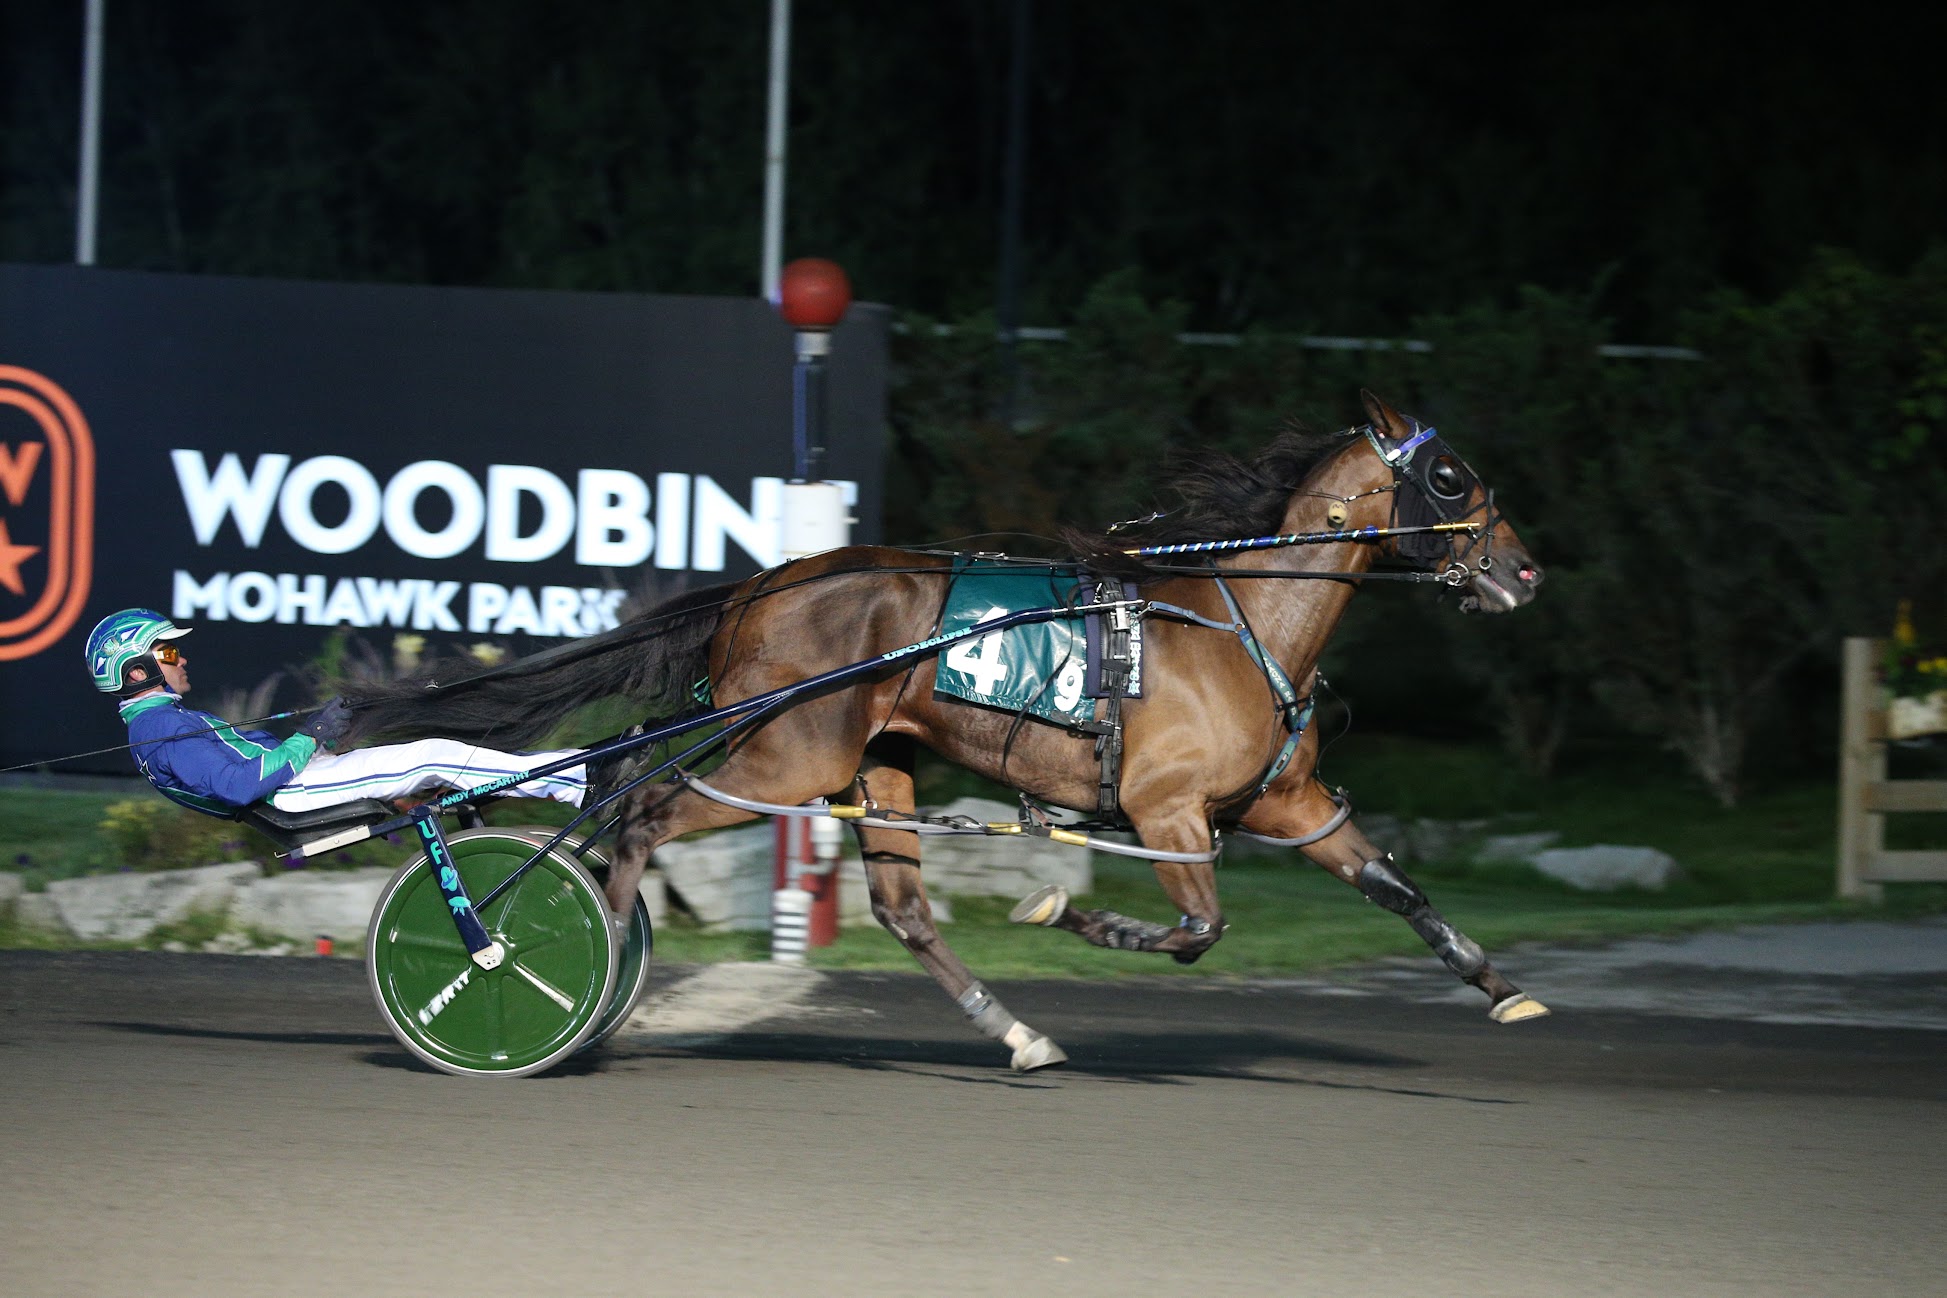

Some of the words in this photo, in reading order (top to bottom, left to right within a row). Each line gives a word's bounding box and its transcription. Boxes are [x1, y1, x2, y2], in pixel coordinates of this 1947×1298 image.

[170, 449, 858, 571] WOODBIN
[172, 569, 462, 632] MOHAWK
[468, 582, 627, 638] PARK
[947, 606, 1008, 696] 4
[1053, 661, 1084, 712] 9
[441, 790, 470, 807] ANDY
[472, 770, 530, 796] McCARTHY
